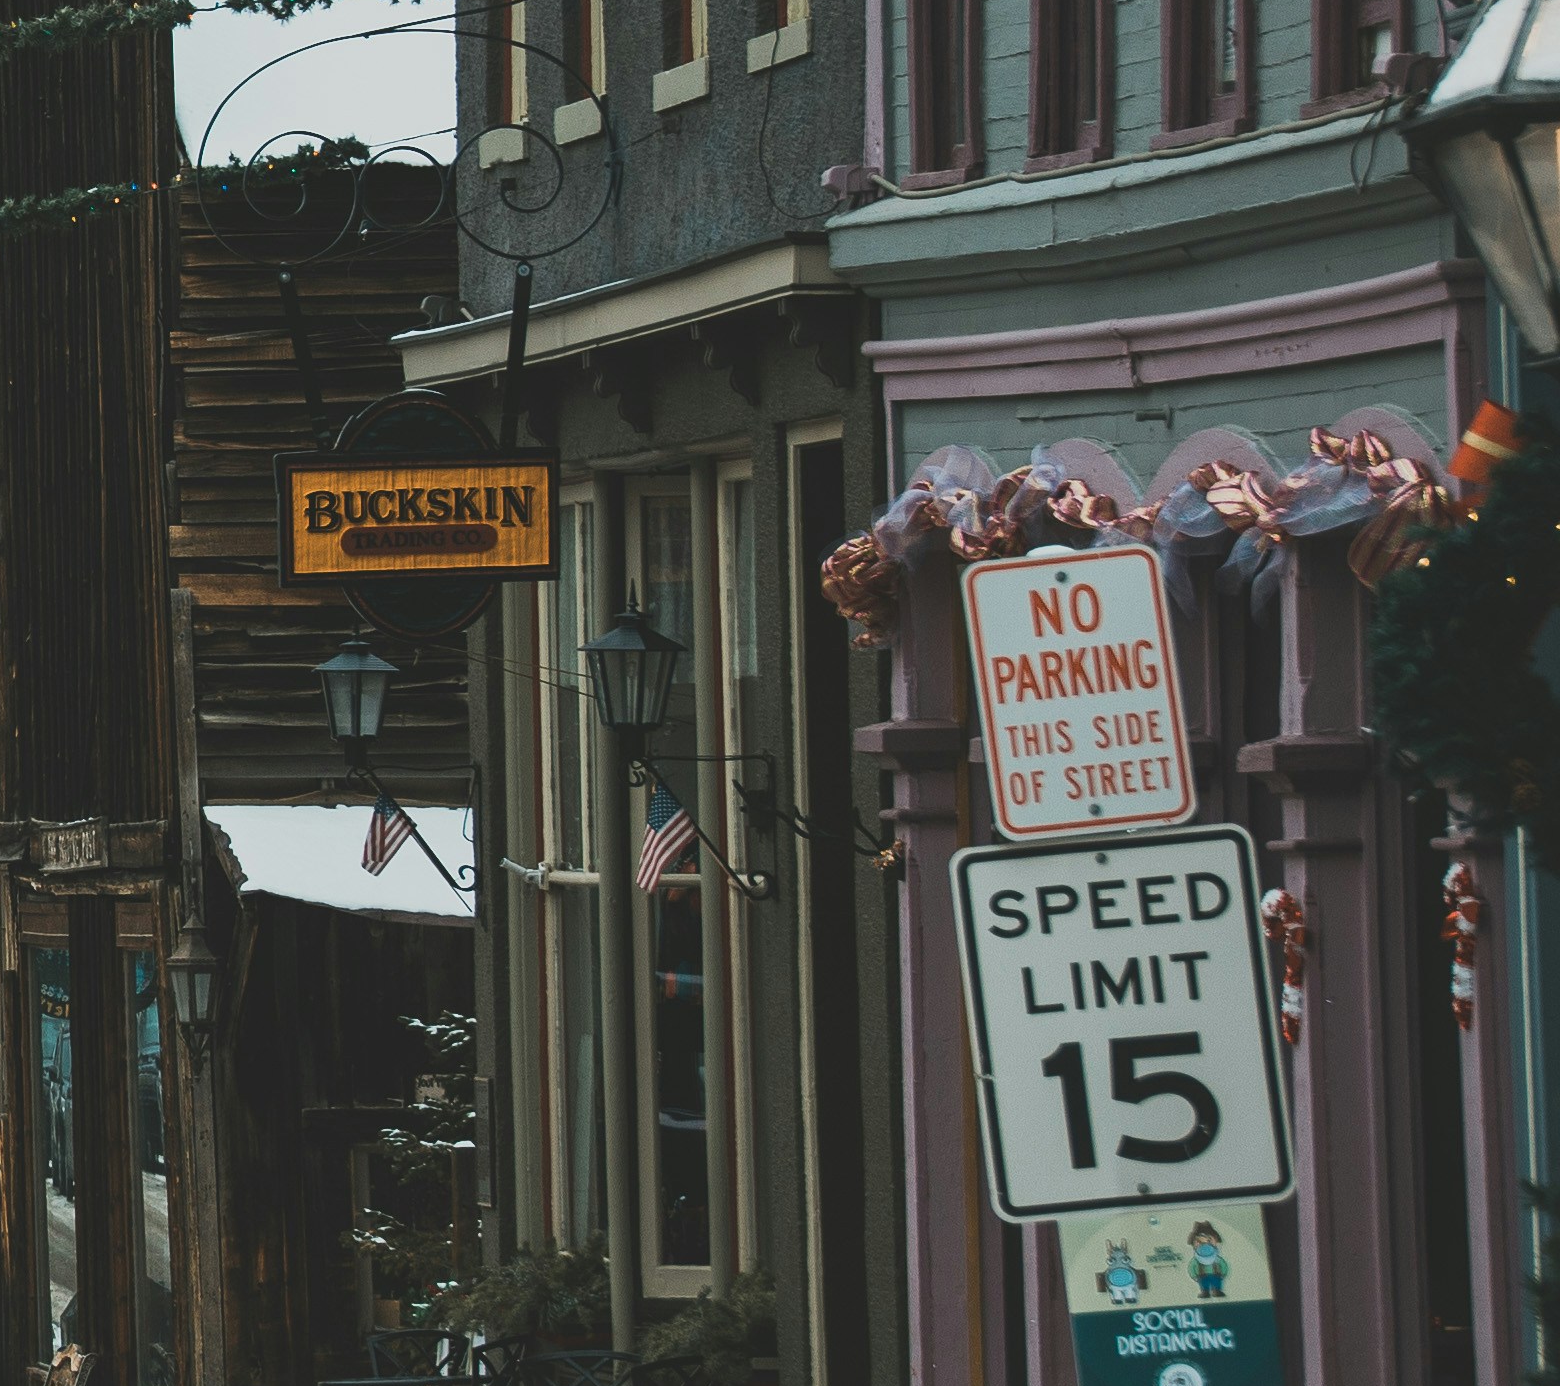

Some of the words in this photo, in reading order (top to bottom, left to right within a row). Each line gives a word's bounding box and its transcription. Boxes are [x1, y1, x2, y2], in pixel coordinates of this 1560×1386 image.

[304, 485, 536, 533] BUCKSKIN
[351, 530, 445, 550] TRADING
[451, 528, 487, 547] CO.
[1028, 583, 1102, 638] NO
[991, 639, 1158, 704] PARKING
[1004, 719, 1074, 758] THIS
[1092, 710, 1164, 749] SIDE
[1009, 770, 1045, 806] OF
[1063, 756, 1171, 800] STREET
[987, 871, 1231, 939] SPEED
[1020, 950, 1210, 1015] LIMIT
[1040, 1030, 1221, 1170] 15
[1116, 1327, 1237, 1357] DISTANCING
[1132, 1307, 1208, 1333] SOCIAL
